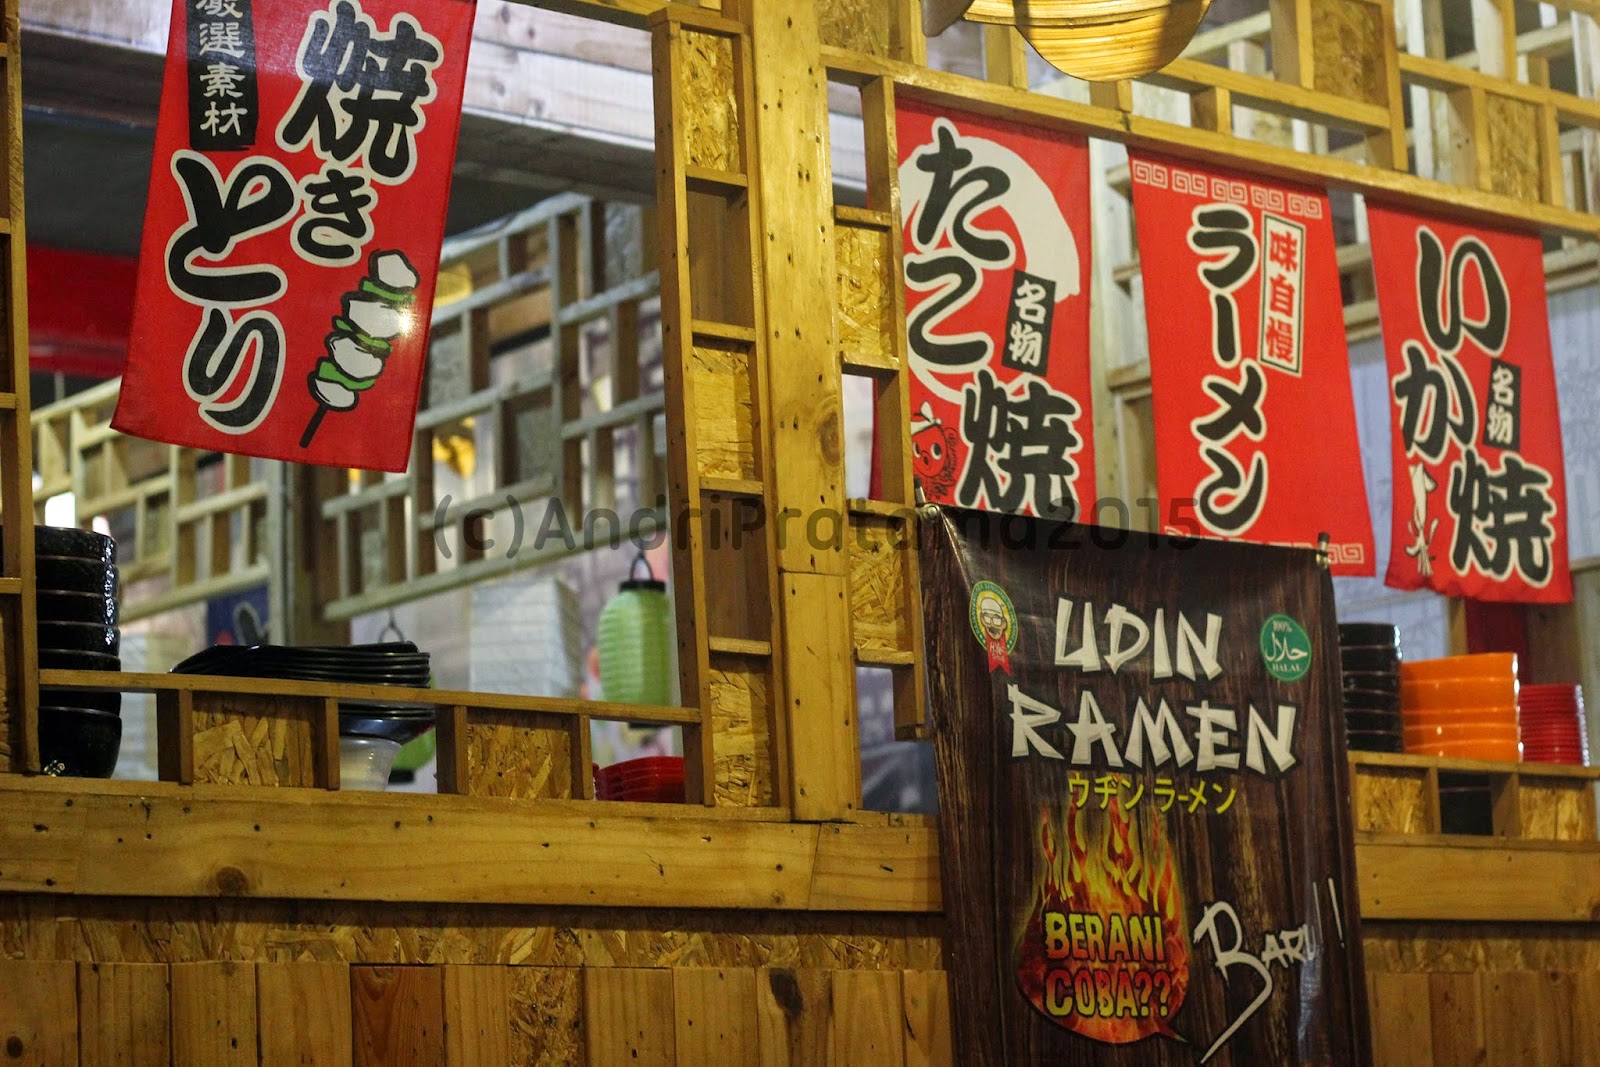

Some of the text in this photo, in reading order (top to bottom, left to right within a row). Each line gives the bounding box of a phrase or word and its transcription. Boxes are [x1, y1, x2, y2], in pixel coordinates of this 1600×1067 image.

[1009, 279, 1048, 368] 名物
[1186, 203, 1268, 536] ラーメン
[1055, 598, 1222, 682] UDIN
[1007, 684, 1297, 774] RAMEN
[1153, 780, 1237, 814] ラーメン
[1044, 911, 1164, 960] BERANI
[1044, 967, 1171, 1018] COBA??
